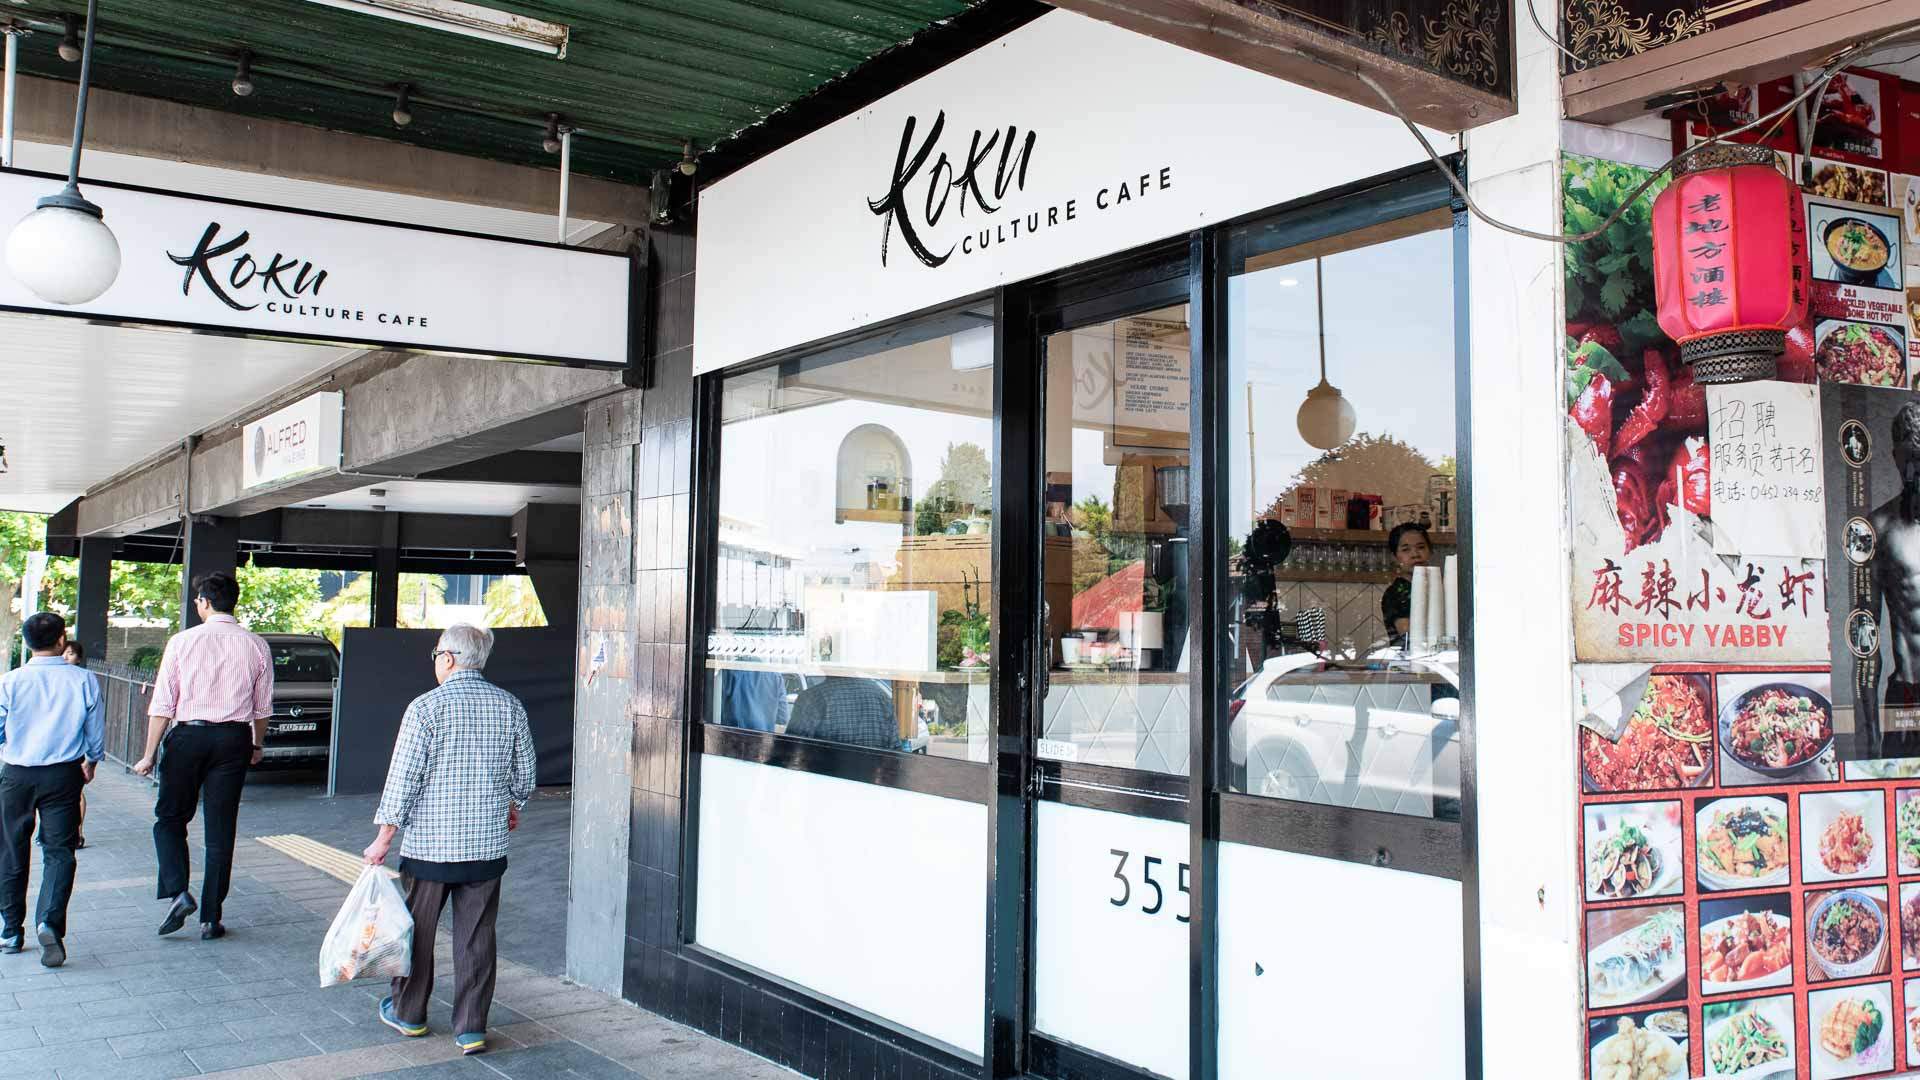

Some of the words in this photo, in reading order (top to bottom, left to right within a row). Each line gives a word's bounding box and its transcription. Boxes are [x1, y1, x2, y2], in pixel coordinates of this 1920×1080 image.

[962, 200, 1077, 255] CULTURE
[1096, 166, 1172, 210] CAFE
[266, 302, 365, 321] CULTURE
[378, 313, 429, 328] CAFE
[1866, 311, 1880, 321] HOT
[1881, 313, 1893, 322] POT
[1867, 300, 1903, 314] VEGETABLE
[267, 420, 307, 456] ALFRED
[1586, 558, 1816, 620] 麻辣小龙虾
[1618, 622, 1695, 648] SPICY
[1704, 624, 1788, 648] YABBY
[1110, 848, 1190, 923] 355
